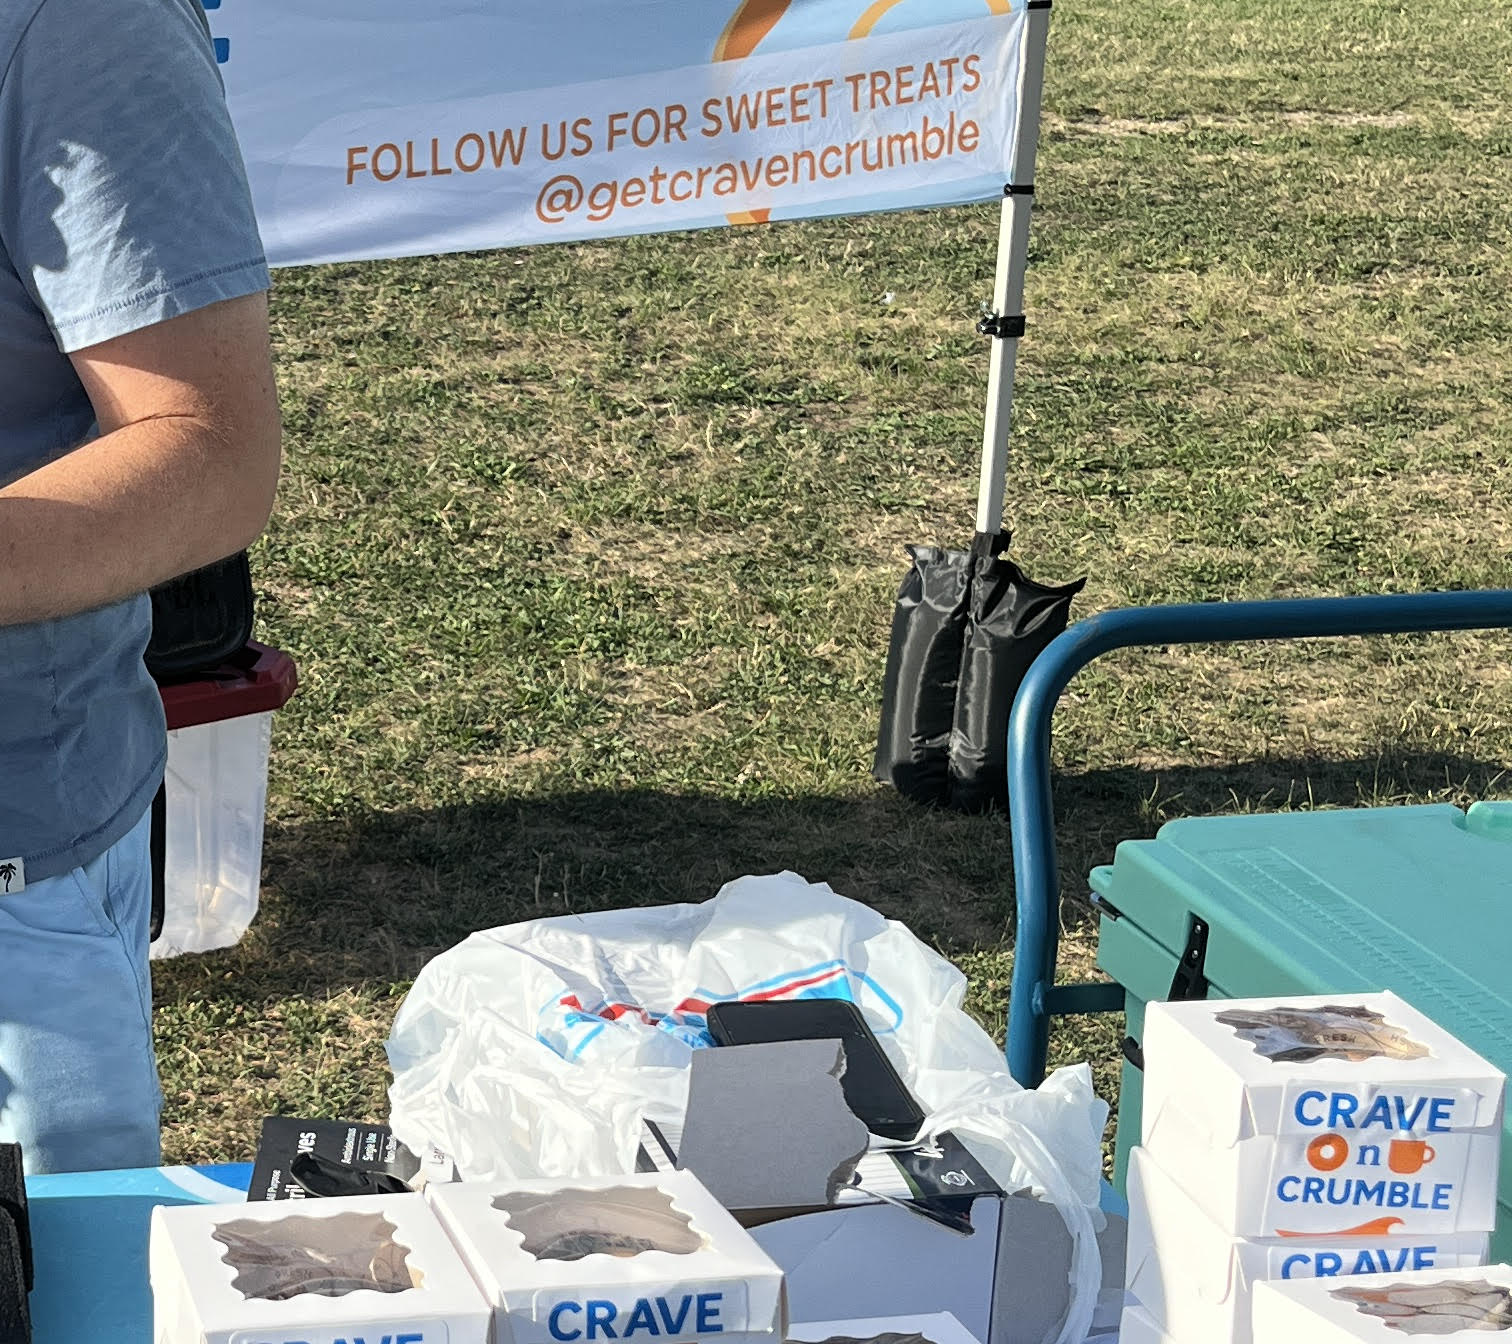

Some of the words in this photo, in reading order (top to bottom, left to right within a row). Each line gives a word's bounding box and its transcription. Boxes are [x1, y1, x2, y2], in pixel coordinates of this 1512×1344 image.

[345, 126, 529, 185] FOLLOW
[540, 117, 593, 161] US
[607, 103, 688, 156] FOR
[701, 78, 834, 137] SWEET
[844, 53, 982, 112] TREATS
[535, 110, 980, 224] @getcravencrumble
[1295, 1090, 1455, 1133] CRAVE
[1277, 1176, 1452, 1210] CRUMBLE
[548, 1292, 724, 1342] CRAVE
